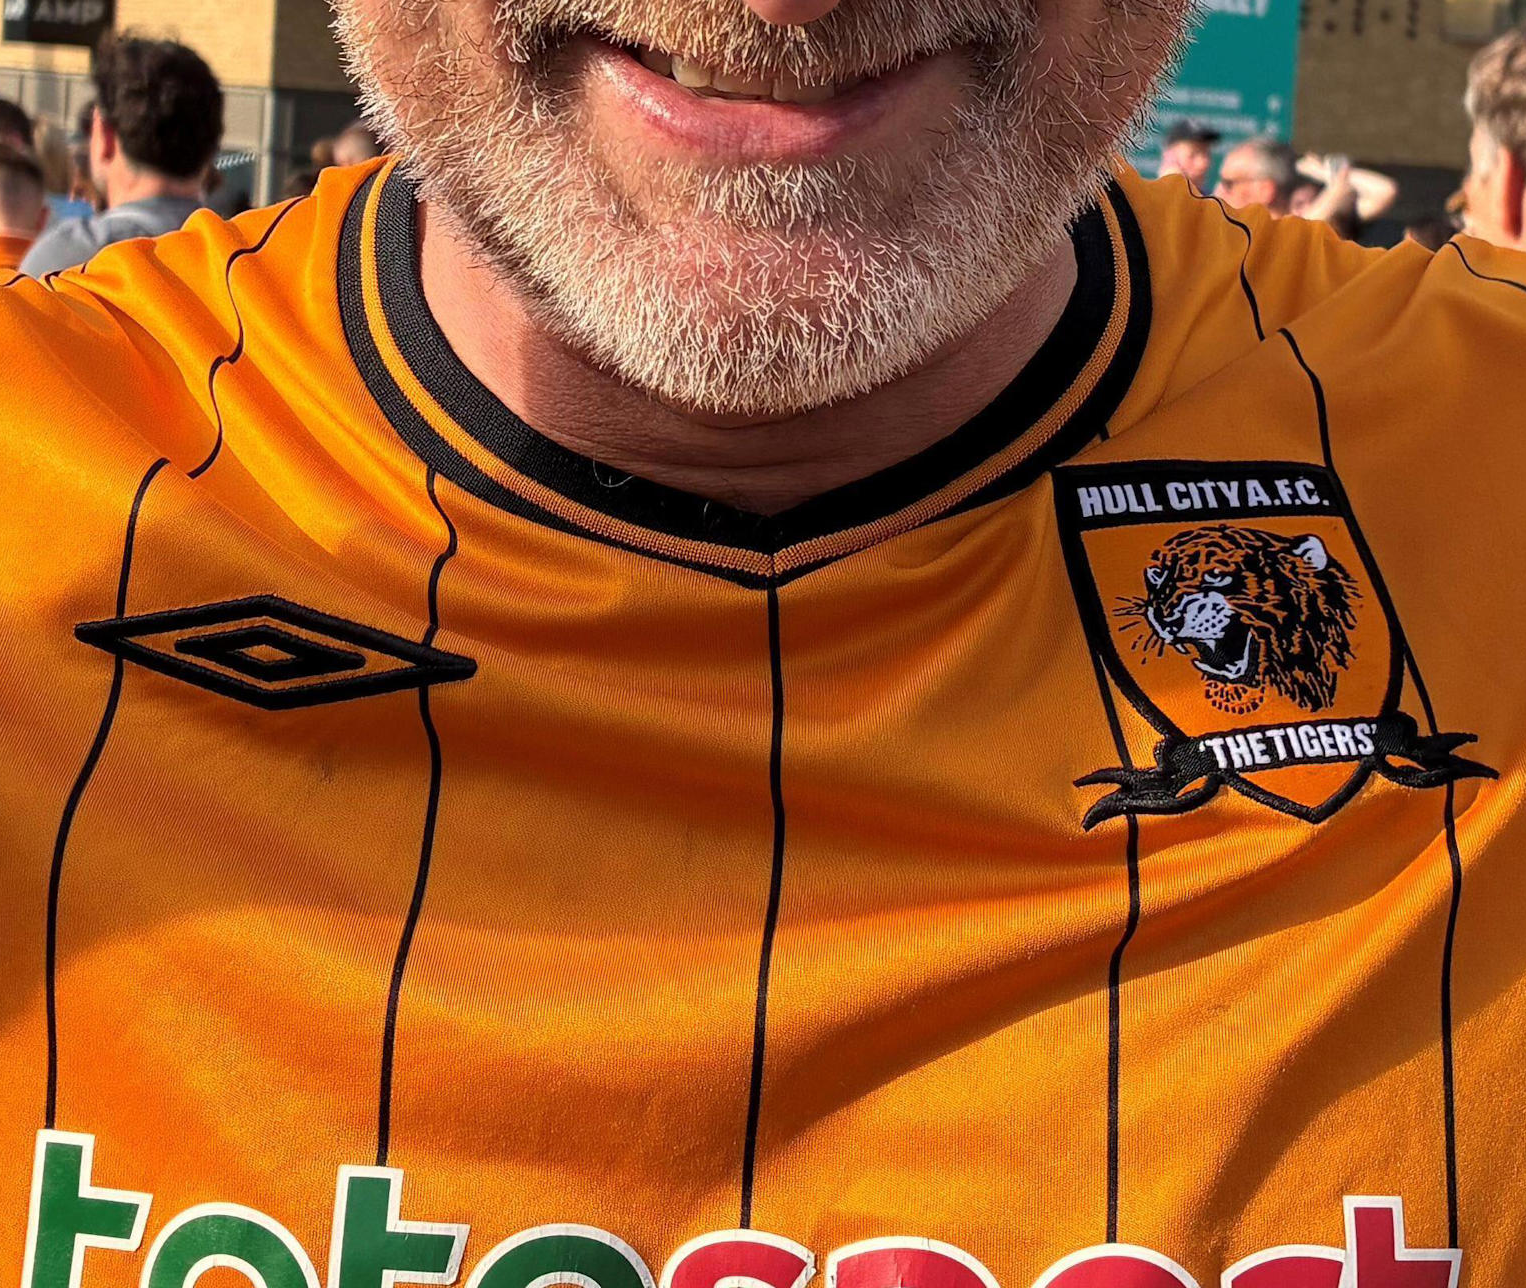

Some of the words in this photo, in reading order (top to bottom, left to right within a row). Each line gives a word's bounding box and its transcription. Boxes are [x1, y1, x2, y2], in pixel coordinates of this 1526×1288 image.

[1076, 482, 1163, 518] HULL
[1165, 479, 1241, 511] CITY
[1244, 476, 1330, 508] A.F.C.
